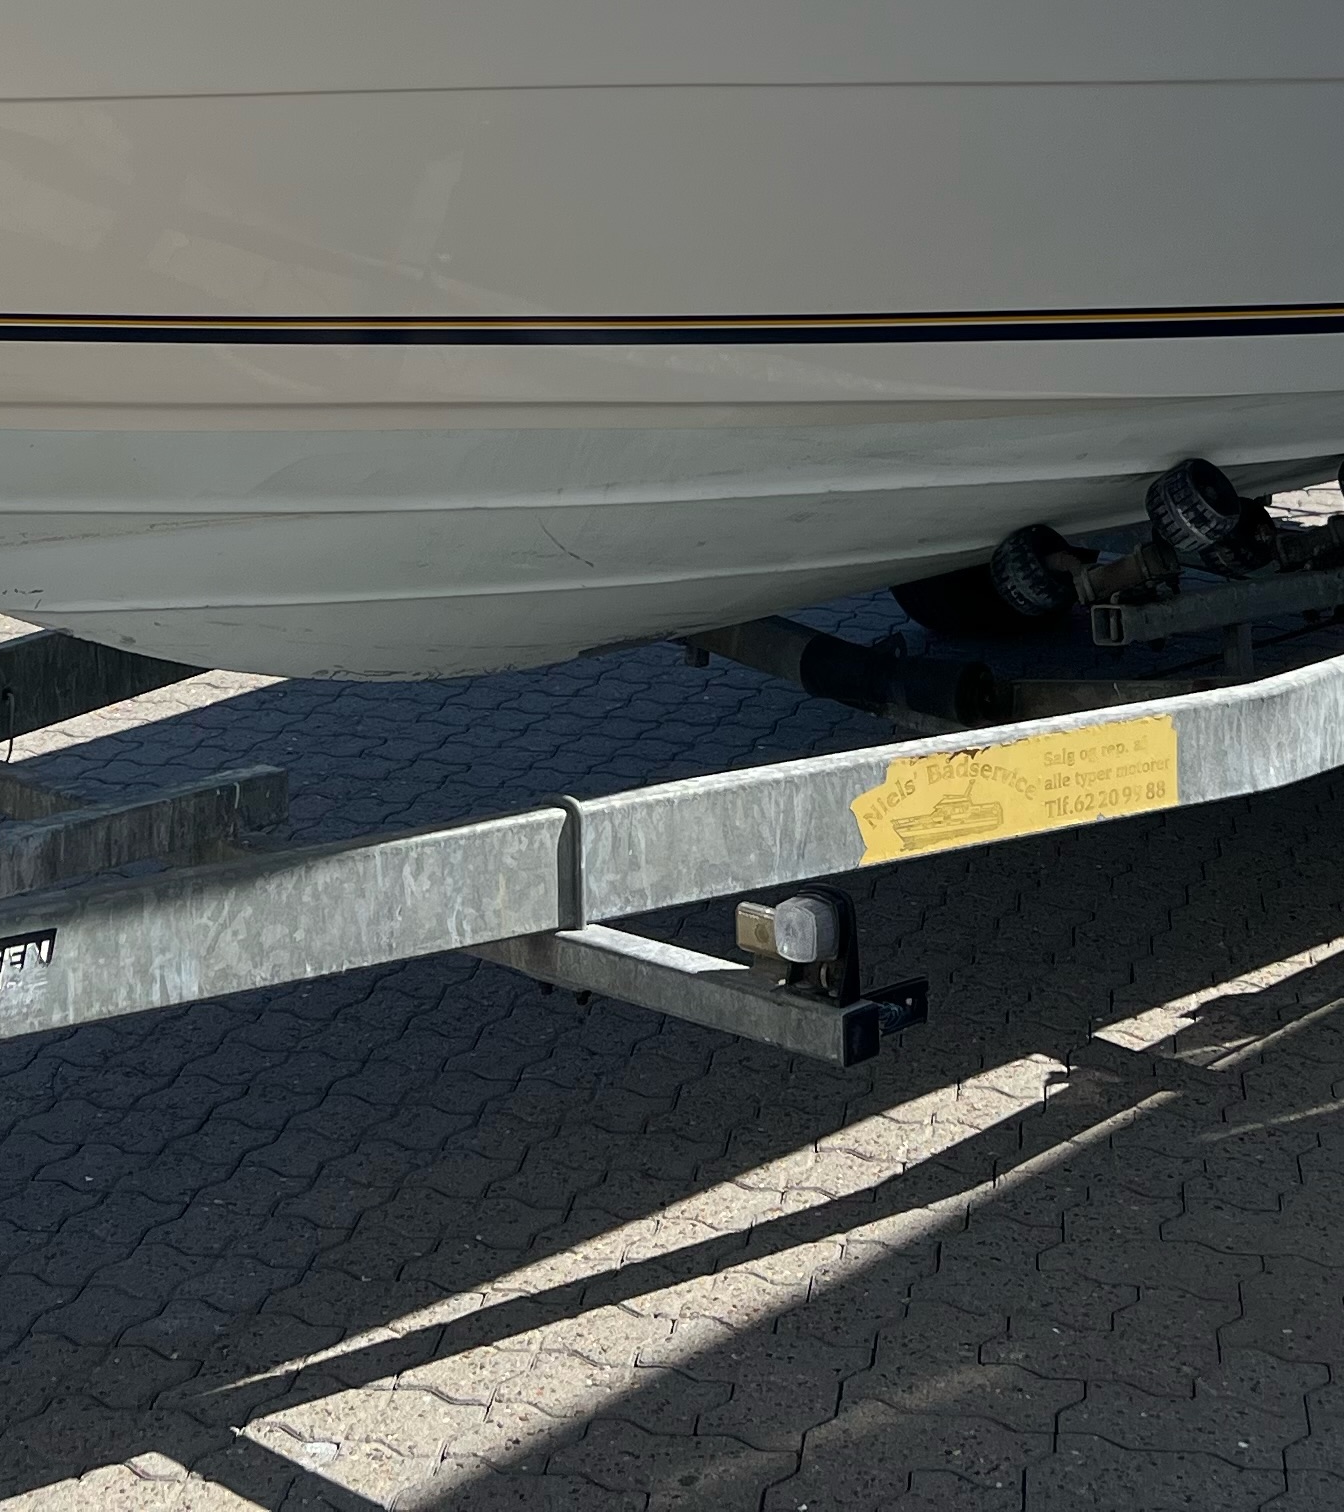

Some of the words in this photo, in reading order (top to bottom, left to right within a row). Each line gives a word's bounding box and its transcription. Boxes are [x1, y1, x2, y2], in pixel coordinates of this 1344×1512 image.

[1043, 747, 1076, 767] Salg
[1101, 742, 1129, 759] rep.
[1044, 772, 1071, 790] alle
[1075, 766, 1113, 789] typer
[1116, 757, 1170, 778] motorer
